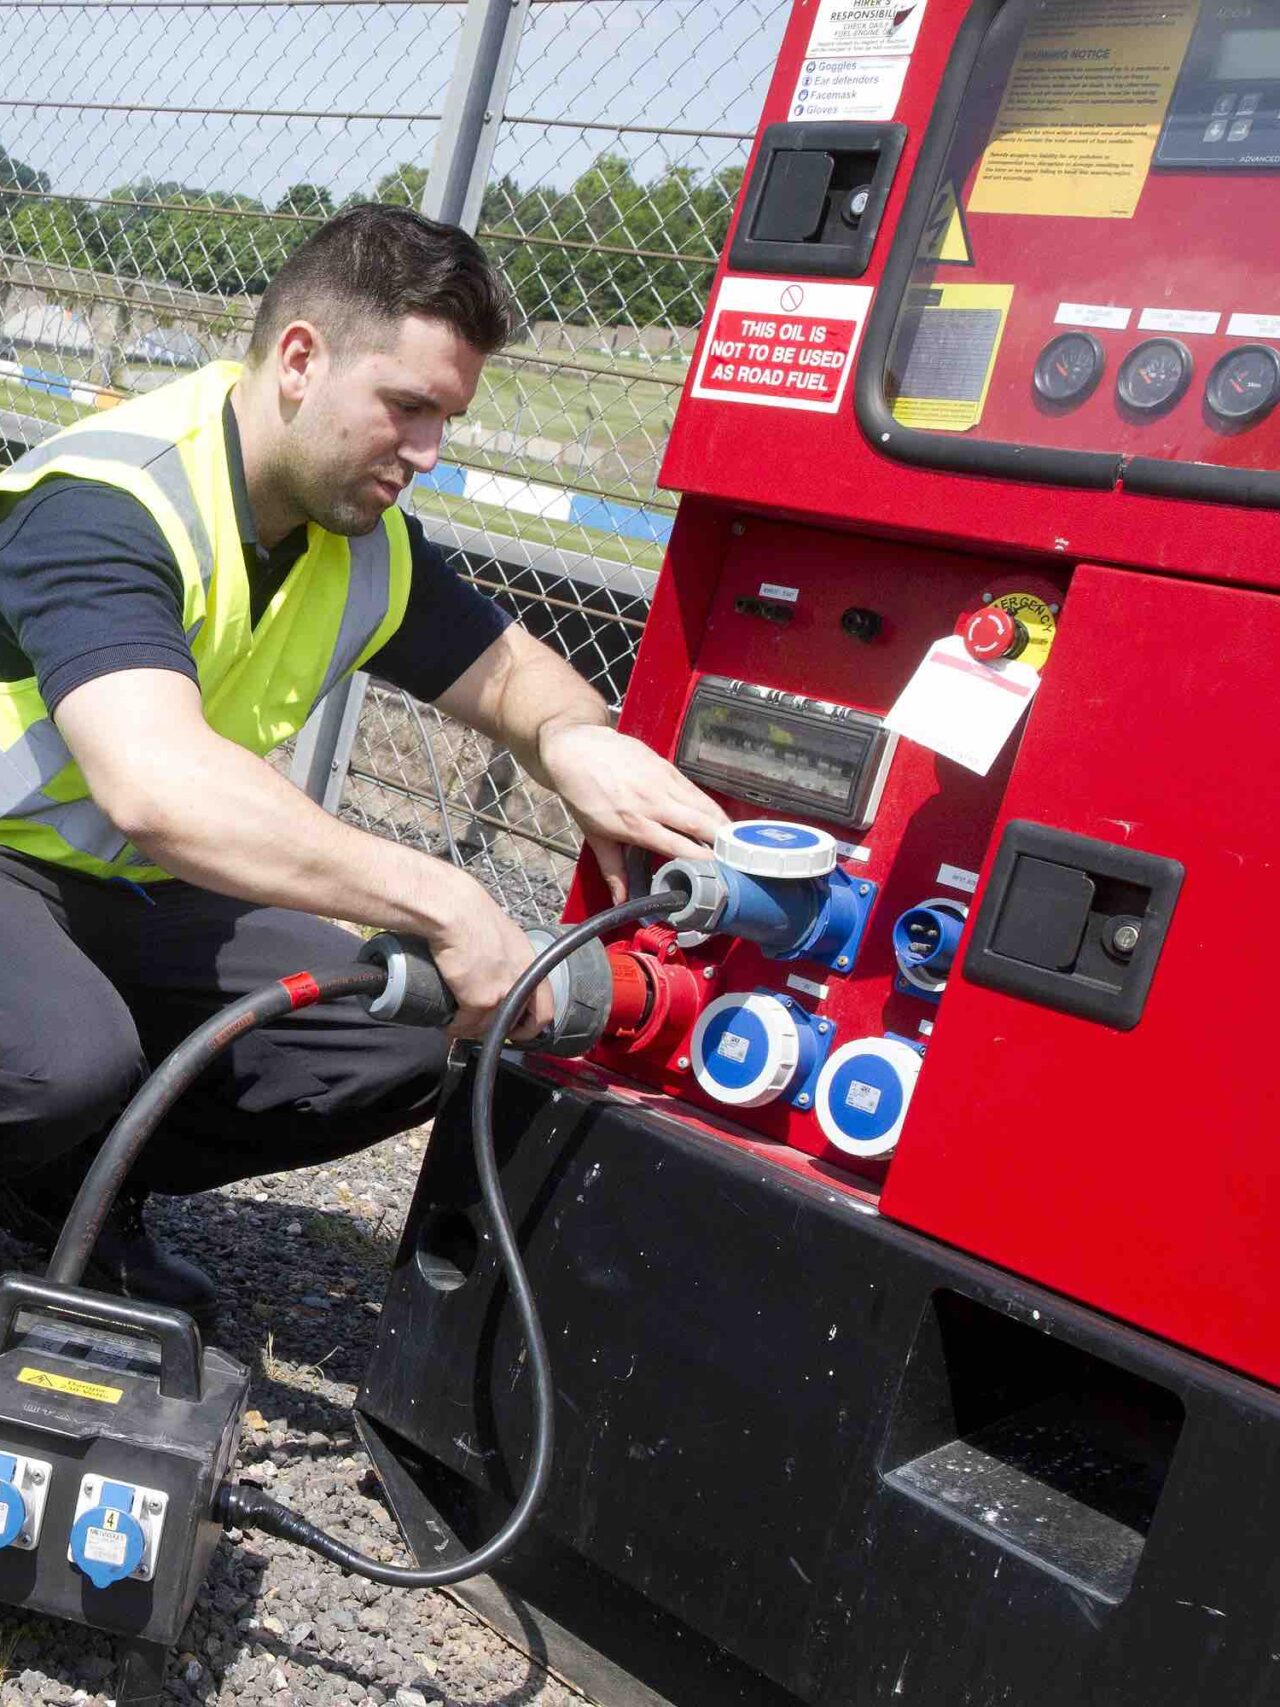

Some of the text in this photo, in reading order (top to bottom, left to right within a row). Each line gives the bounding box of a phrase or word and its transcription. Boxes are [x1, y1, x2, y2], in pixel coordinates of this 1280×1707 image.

[830, 9, 897, 21] RESPONSIBILI
[1071, 48, 1112, 60] NOTICE
[818, 61, 857, 73] Goggles
[814, 75, 880, 86] Ear defenders
[810, 90, 857, 100] Facemask
[806, 105, 839, 115] Gloves
[741, 319, 827, 343] THIS OIL IS
[710, 340, 846, 369] NOT TO BE USED
[711, 364, 829, 391] AS ROAD FUEL
[1000, 596, 1054, 633] ERGENCY
[105, 1511, 115, 1527] 4
